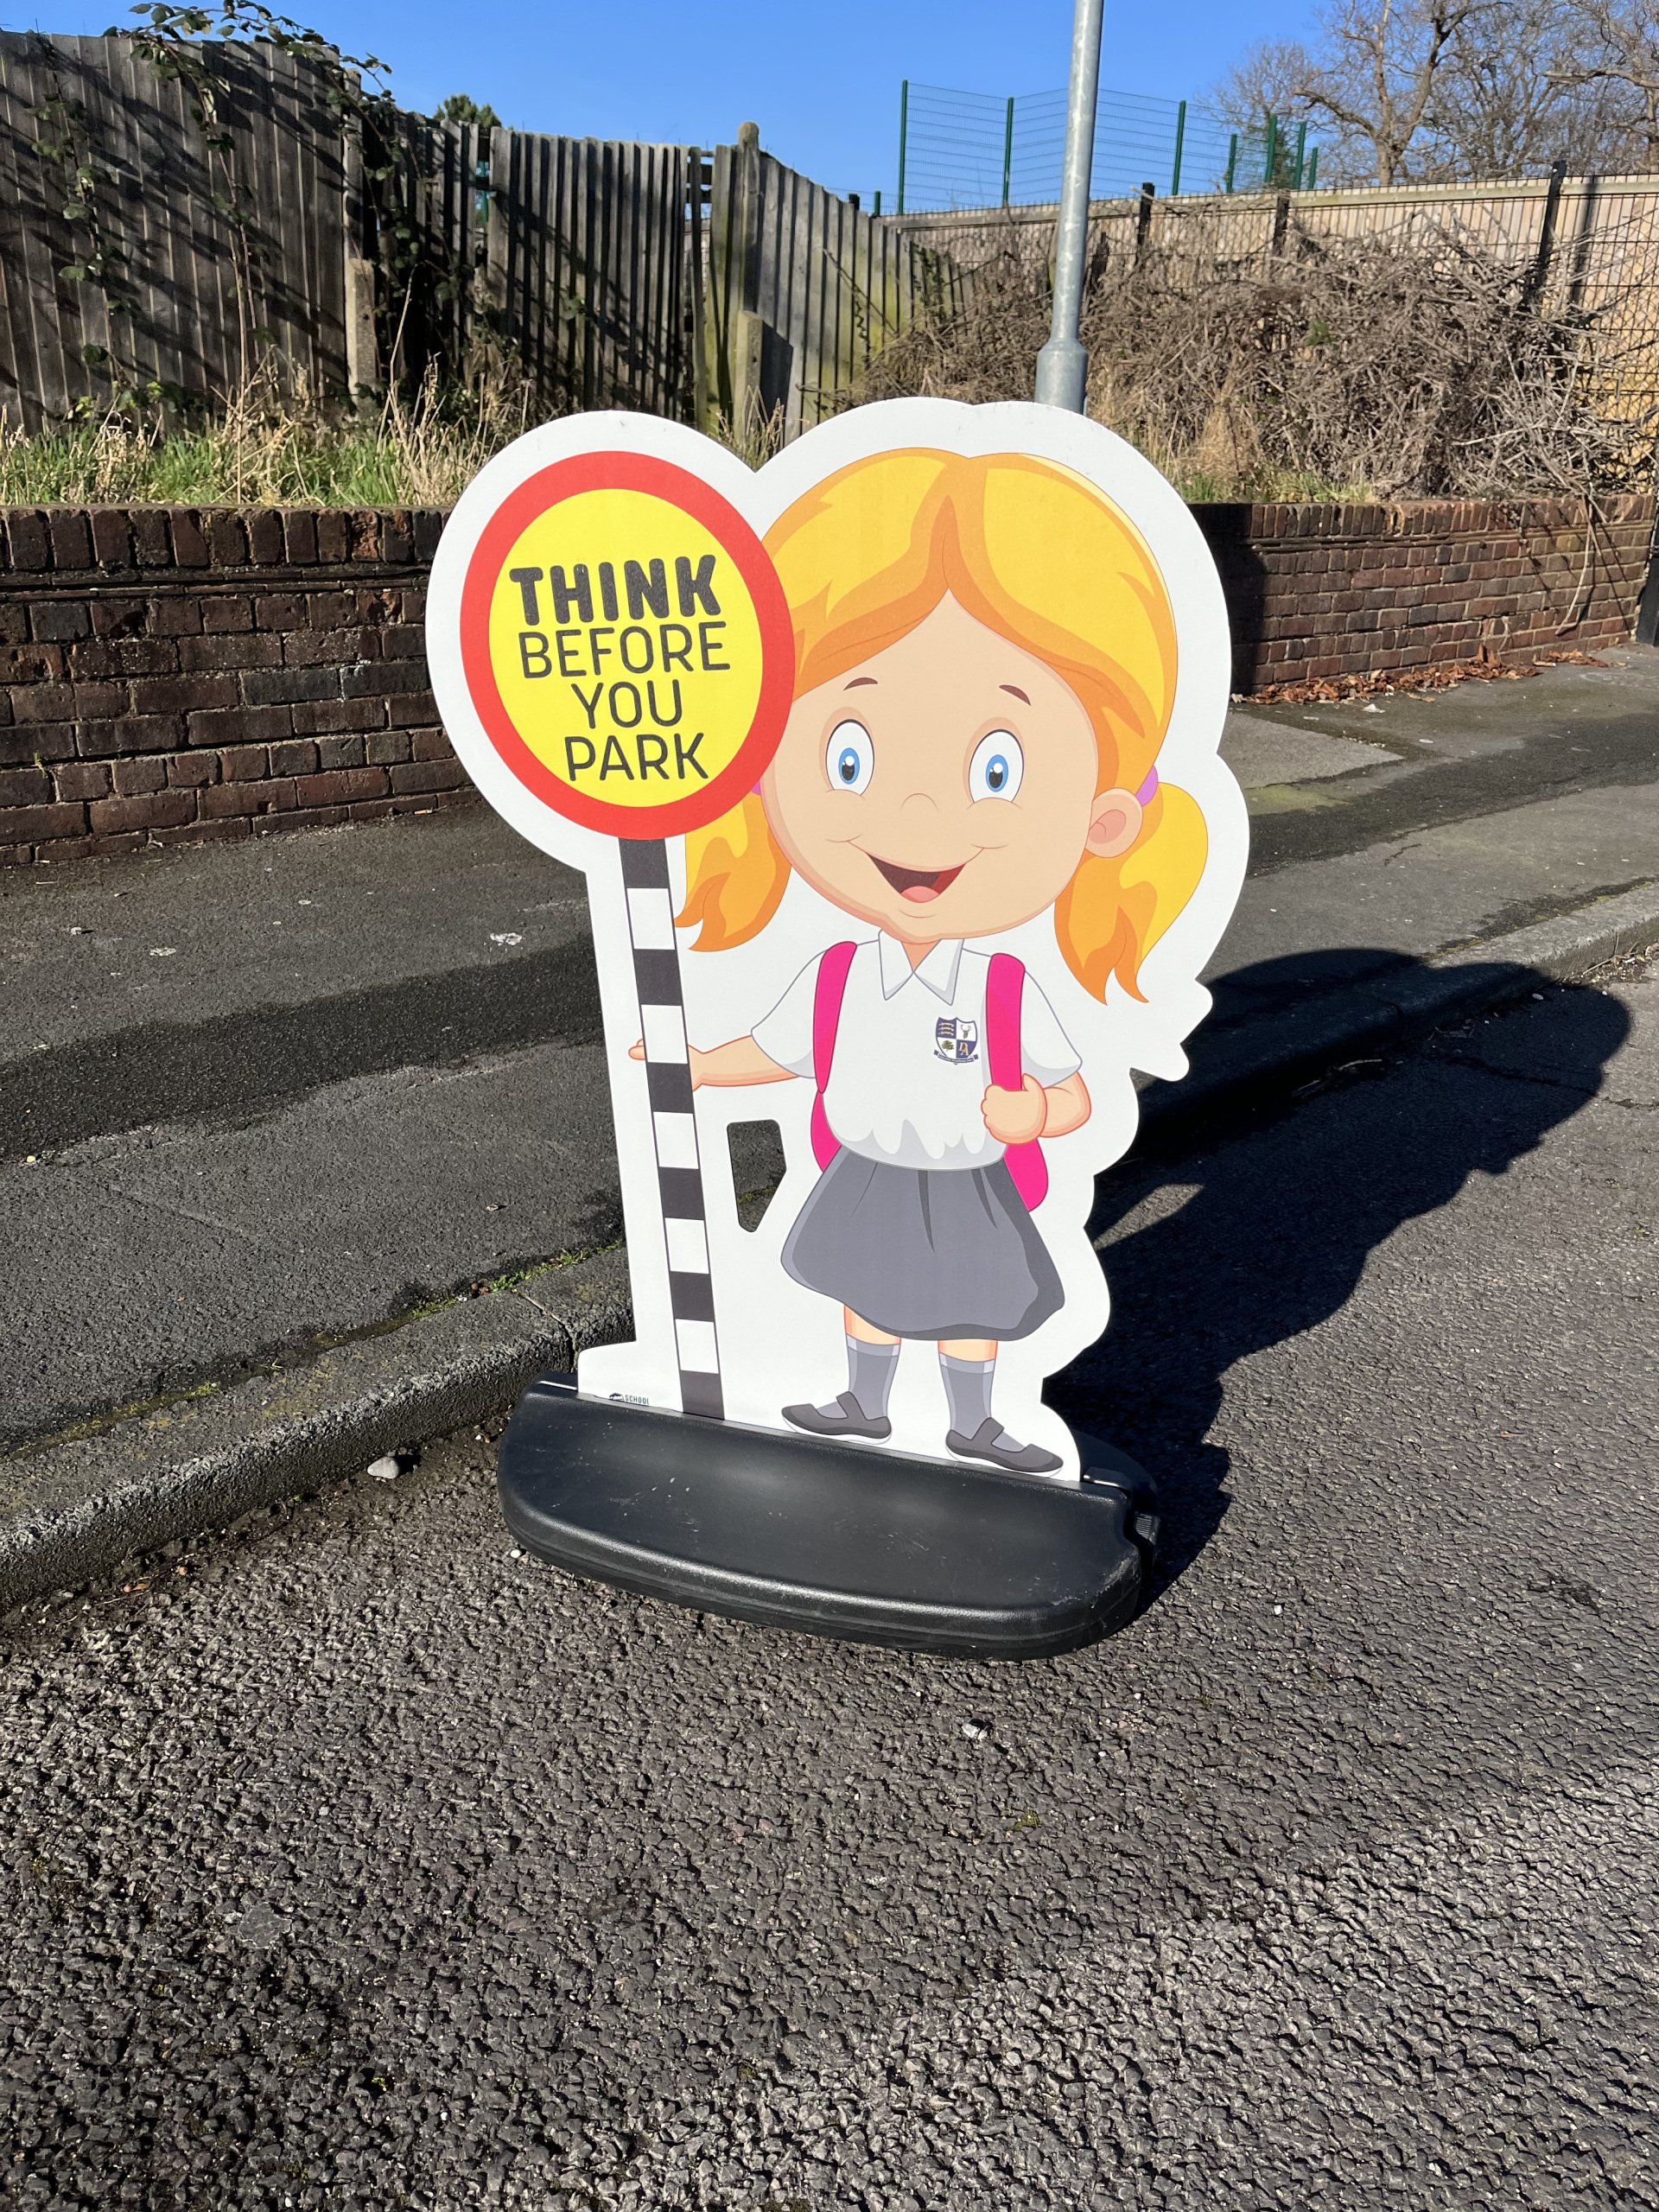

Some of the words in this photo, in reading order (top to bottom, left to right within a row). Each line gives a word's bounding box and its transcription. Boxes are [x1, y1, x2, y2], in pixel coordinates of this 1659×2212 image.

[509, 555, 721, 626] THINK
[518, 620, 731, 679] BEFORE
[570, 679, 683, 729] YOU
[564, 732, 709, 781] PARK
